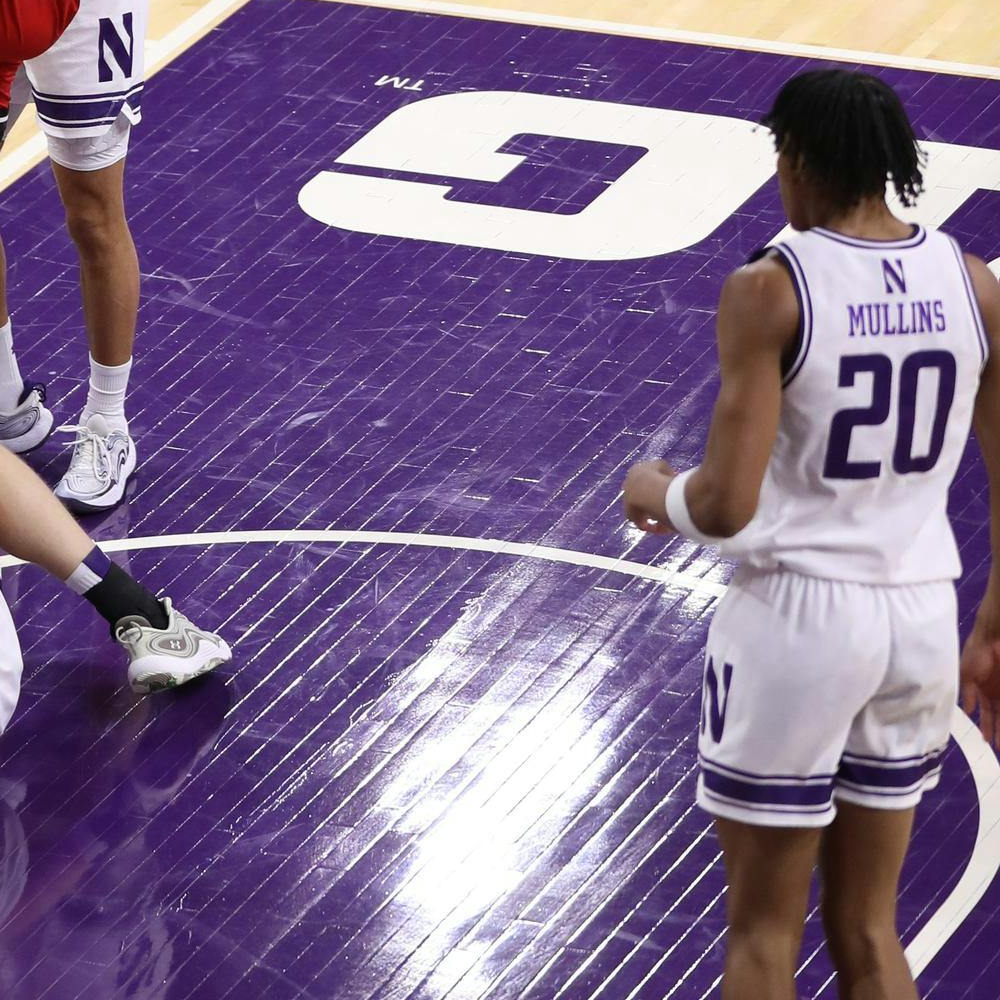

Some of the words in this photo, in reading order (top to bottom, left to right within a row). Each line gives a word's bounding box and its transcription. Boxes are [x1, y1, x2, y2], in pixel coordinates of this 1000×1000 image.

[98, 12, 134, 83] N
[881, 257, 908, 295] N
[846, 299, 947, 338] MULLINS
[822, 349, 957, 480] 20
